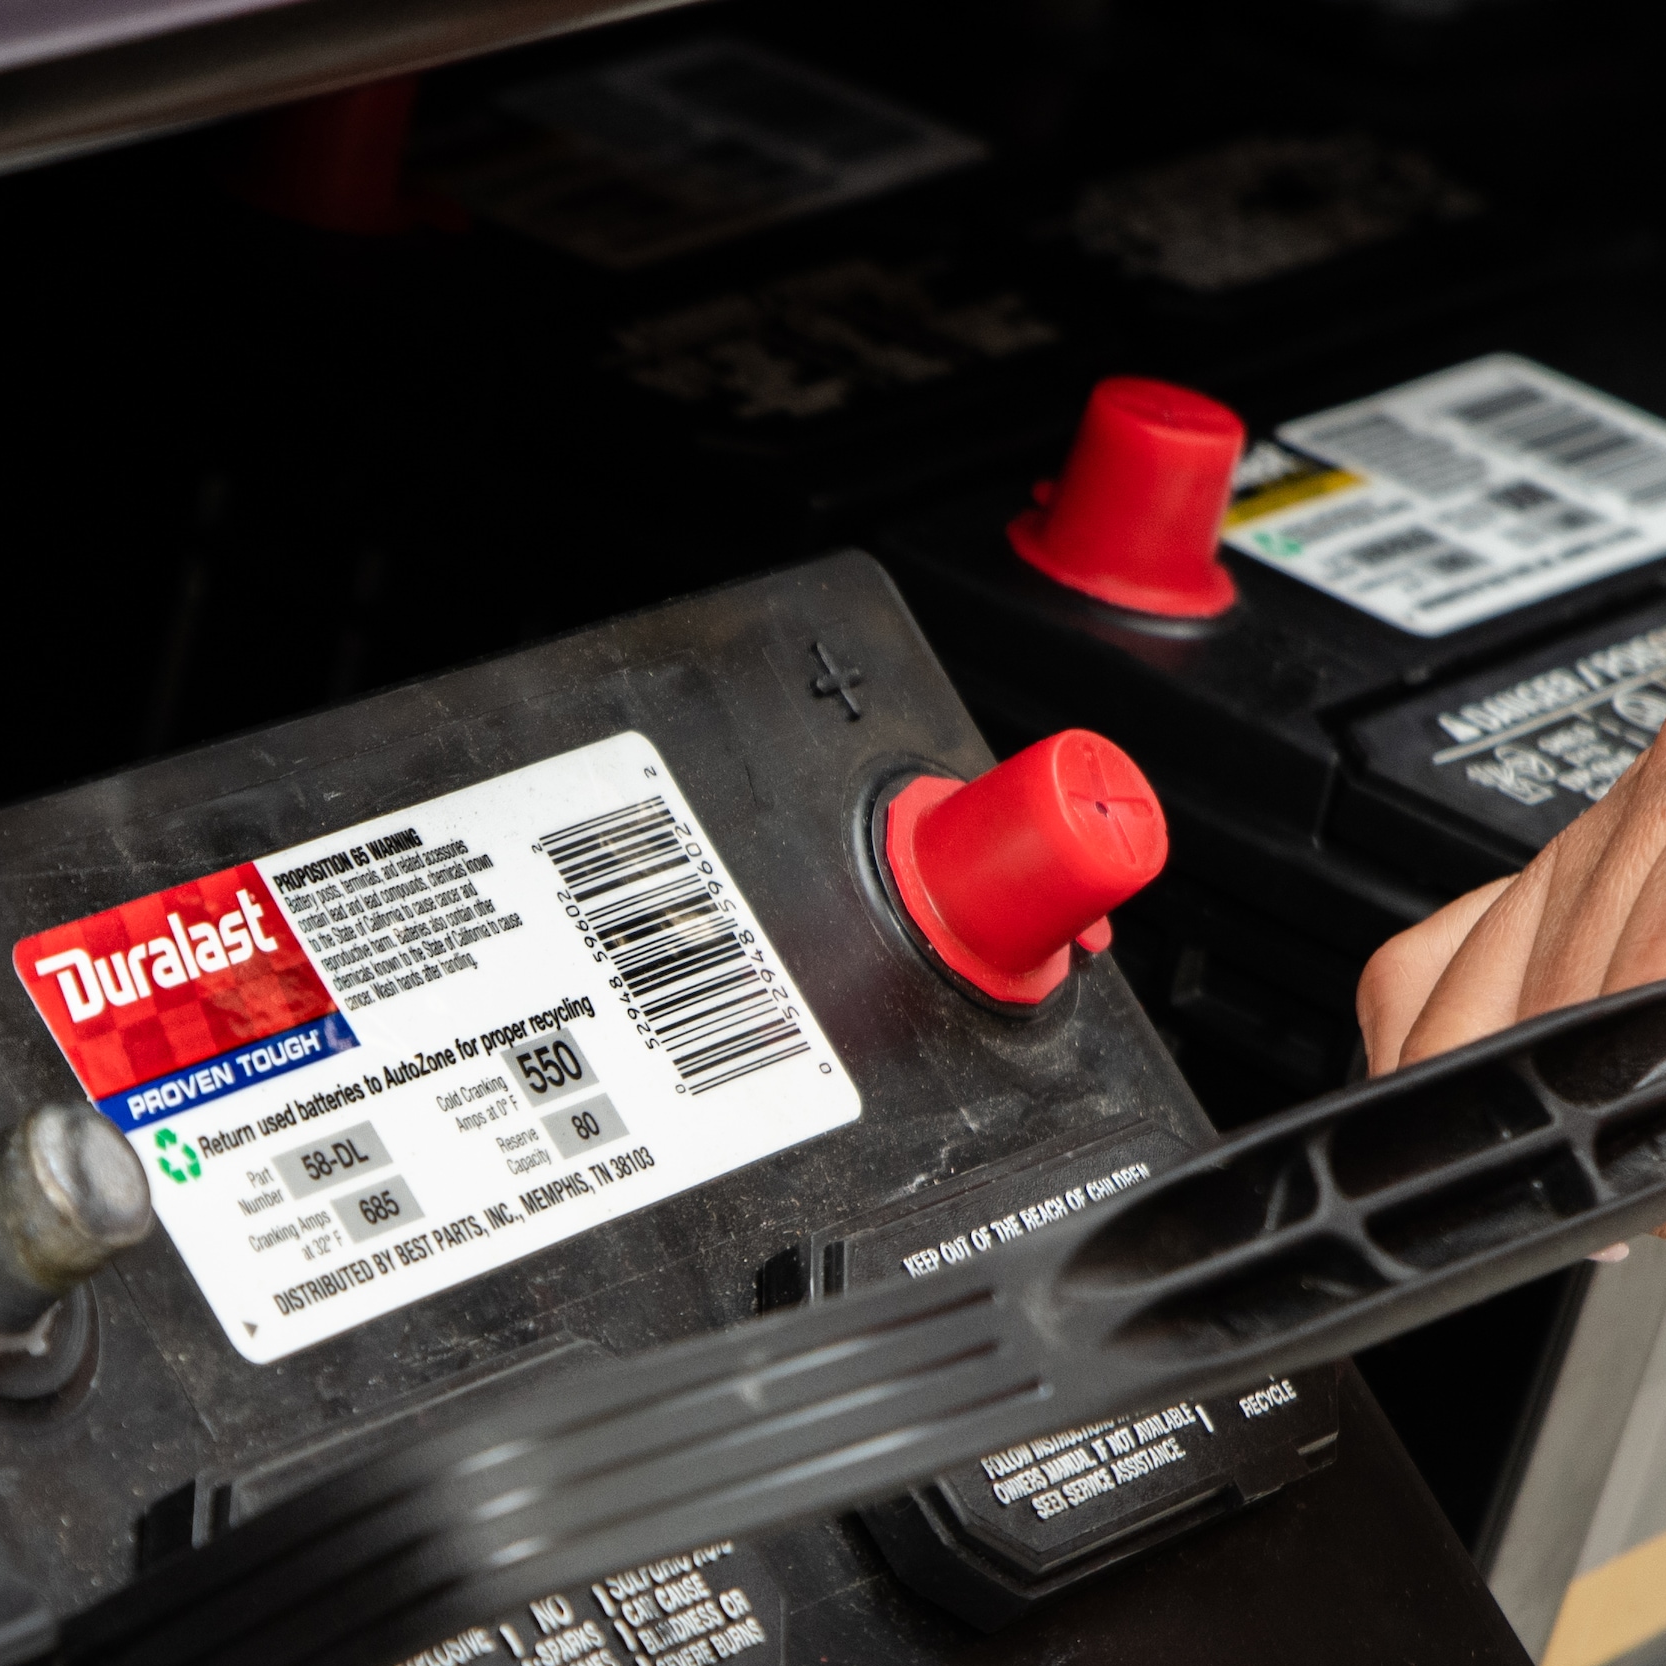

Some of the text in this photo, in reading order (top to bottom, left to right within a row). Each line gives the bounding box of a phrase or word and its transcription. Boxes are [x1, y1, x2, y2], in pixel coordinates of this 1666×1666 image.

[273, 828, 422, 894] PROPOSITION 65 WARNING
[285, 840, 468, 913] Battery posts, terminals, and related accessories
[298, 854, 493, 933] contain lead and lead compounds, chemicals known
[309, 879, 478, 952] to the State of California to cause cancer and
[34, 889, 277, 1022] Duralast
[321, 899, 495, 971] reproductive harm. Batteries also contain other
[333, 913, 522, 991] chemicals known to the State of California to cause
[345, 953, 477, 1010] cancer. Wash hands after handling.
[127, 1030, 319, 1119] PROVEN TOUGH
[199, 996, 595, 1157] Return used batteries to AutoZone for proper recycling
[516, 1040, 582, 1093] 550
[436, 1077, 508, 1111] Cold Cranking
[456, 1112, 487, 1132] Amps
[487, 1106, 499, 1120] at
[509, 1095, 517, 1110] F
[496, 1129, 539, 1152] Reserve
[572, 1112, 600, 1139] 80
[247, 1168, 273, 1187] Part
[301, 1139, 369, 1180] 58-DL
[507, 1149, 551, 1174] Capacity
[238, 1189, 283, 1215] Number
[359, 1190, 399, 1224] 685
[249, 1211, 331, 1251] Cranking Amps
[274, 1147, 654, 1315] DISTRIBUTED BY BEST PARTS, INC., MEMPHIS, TN 38103
[302, 1245, 315, 1260] at
[333, 1230, 341, 1245] F
[902, 1248, 939, 1279] KEEP
[939, 1235, 972, 1265] OUT
[970, 1225, 992, 1252] OF
[990, 1214, 1023, 1243] THE
[1019, 1196, 1069, 1232] REACH
[1064, 1187, 1086, 1211] OF
[1238, 1378, 1298, 1419] RECYCLE
[980, 1443, 1034, 1480] FOLLOW
[1029, 1417, 1114, 1460] INSTRUC
[992, 1467, 1048, 1505] OWNERS
[1091, 1439, 1109, 1462] IF
[1106, 1429, 1136, 1457] NOT
[1133, 1402, 1196, 1445] AVAILABLE
[1032, 1437, 1187, 1520] SEEK SERVICE ASSISTANCE.
[529, 1594, 574, 1634] NO
[654, 1572, 711, 1614] CAUSE
[719, 1587, 751, 1620] OR
[709, 1617, 766, 1659] BURNS
